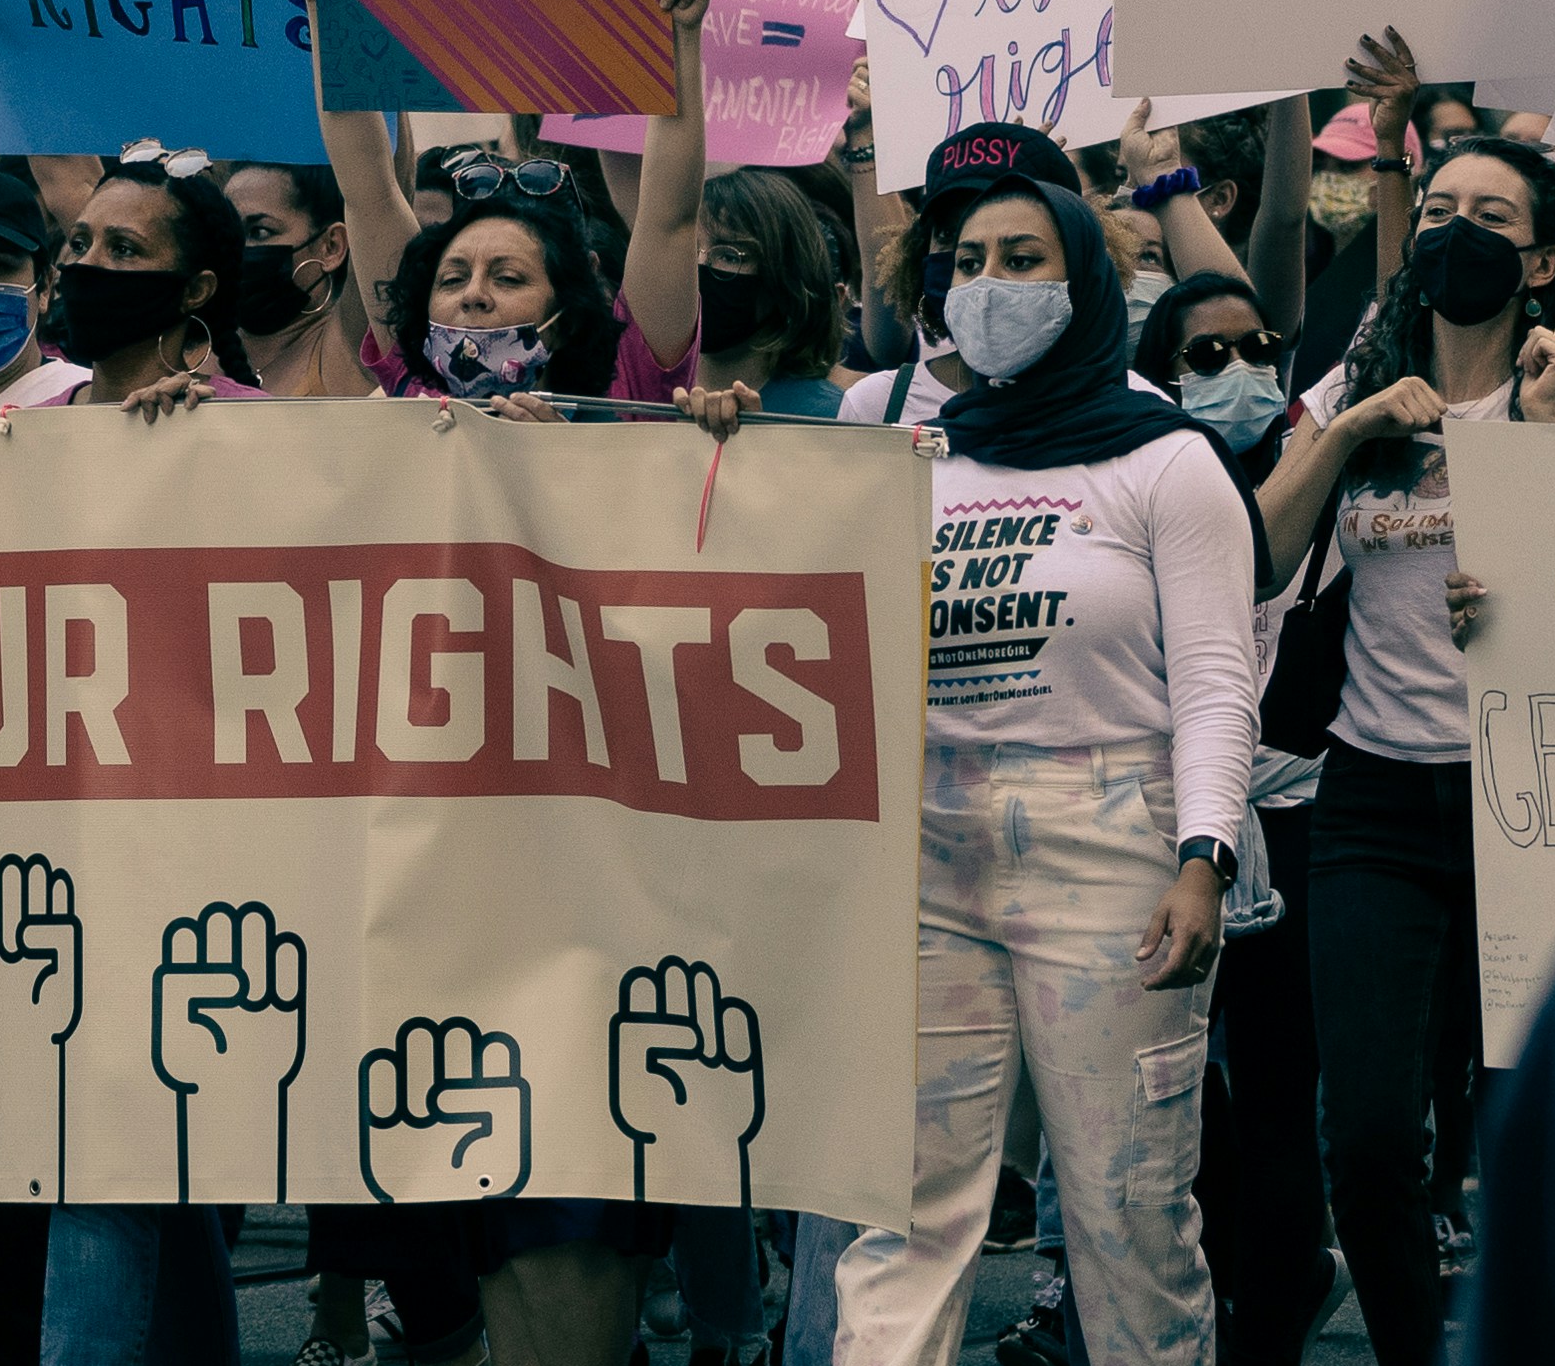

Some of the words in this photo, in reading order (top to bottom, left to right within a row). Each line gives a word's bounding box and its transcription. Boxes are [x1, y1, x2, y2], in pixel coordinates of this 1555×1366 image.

[942, 138, 1022, 172] PUSSY
[932, 514, 1061, 554] SILENCE
[1360, 537, 1389, 552] WE
[1405, 531, 1453, 551] RISE
[959, 553, 1033, 590] NOT
[208, 576, 842, 785] RIGHTS
